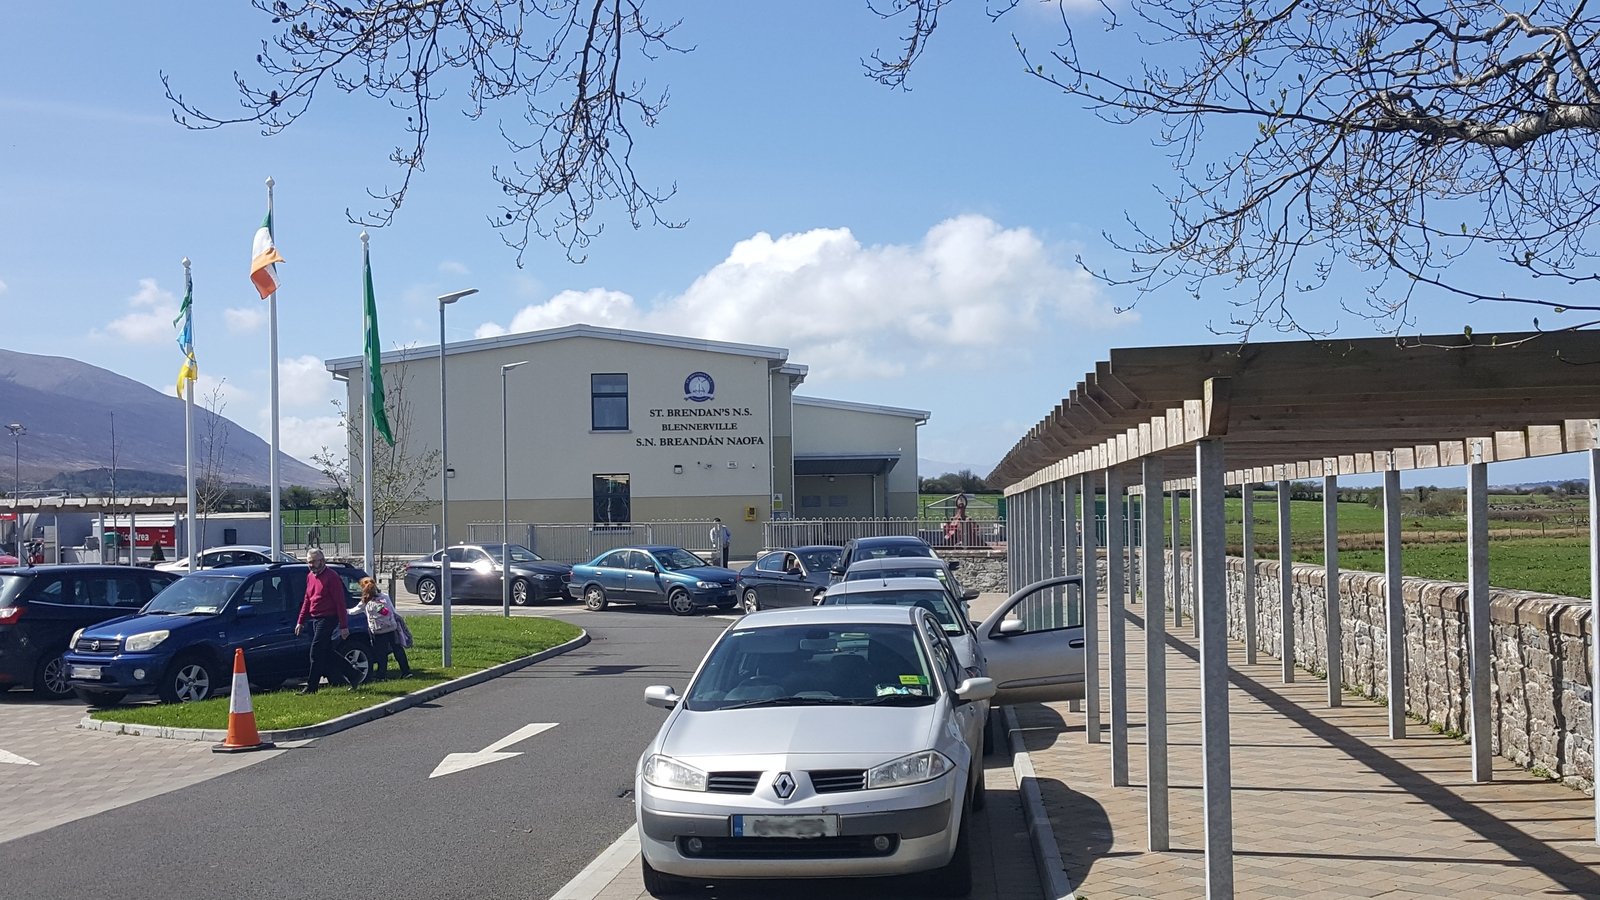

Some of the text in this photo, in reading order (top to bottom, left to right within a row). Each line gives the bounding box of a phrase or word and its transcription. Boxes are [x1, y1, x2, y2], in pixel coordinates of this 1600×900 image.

[649, 407, 753, 418] ST. BRENDAN'S N.S.
[661, 422, 738, 431] BLENNERVILLE
[635, 435, 764, 447] S.N. BREANDÁN NAOFA
